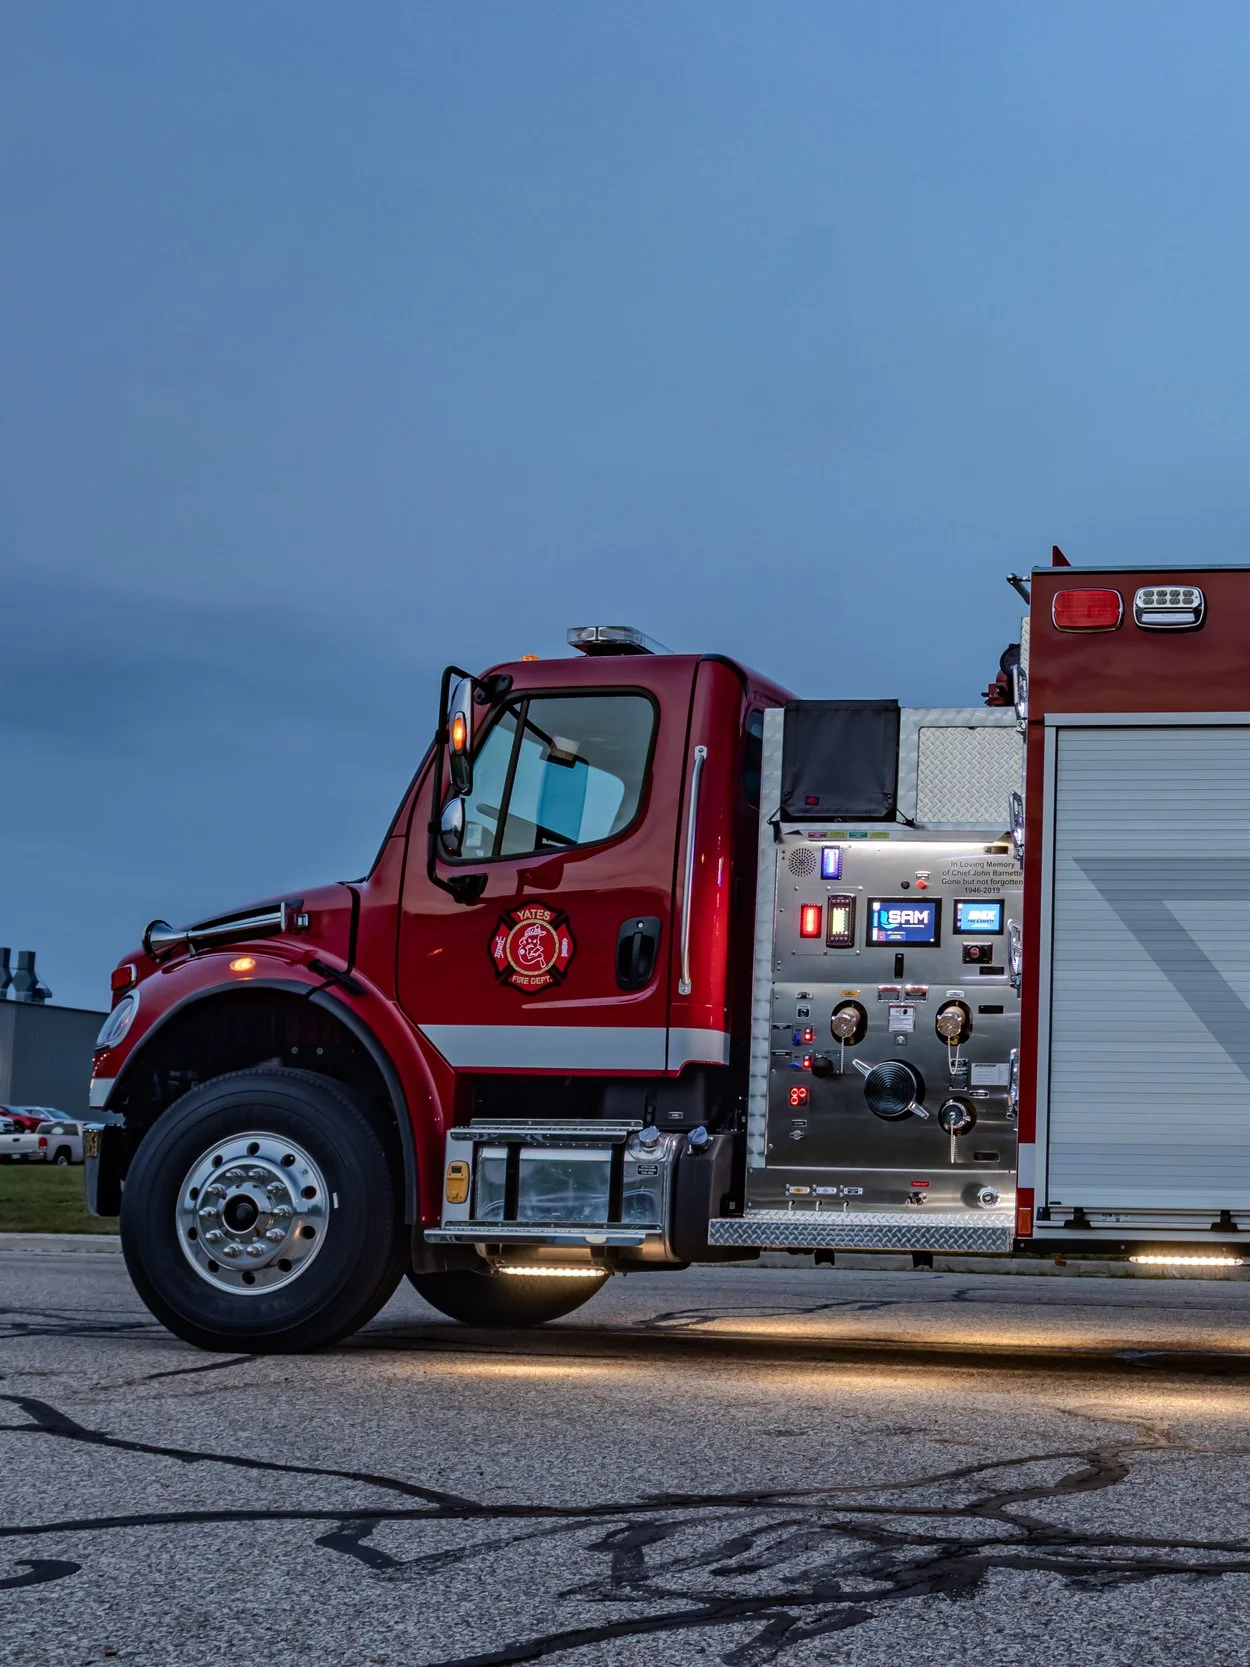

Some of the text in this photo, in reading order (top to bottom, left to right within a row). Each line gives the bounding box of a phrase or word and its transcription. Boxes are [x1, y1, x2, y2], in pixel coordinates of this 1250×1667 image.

[959, 861, 985, 869] Loving
[986, 861, 1016, 869] Memory
[942, 869, 1023, 877] of Chief John Barnette
[990, 878, 1024, 887] forgotten
[517, 909, 551, 921] YATES
[888, 910, 929, 924] SAM
[511, 975, 553, 985] FIRE DEPT.
